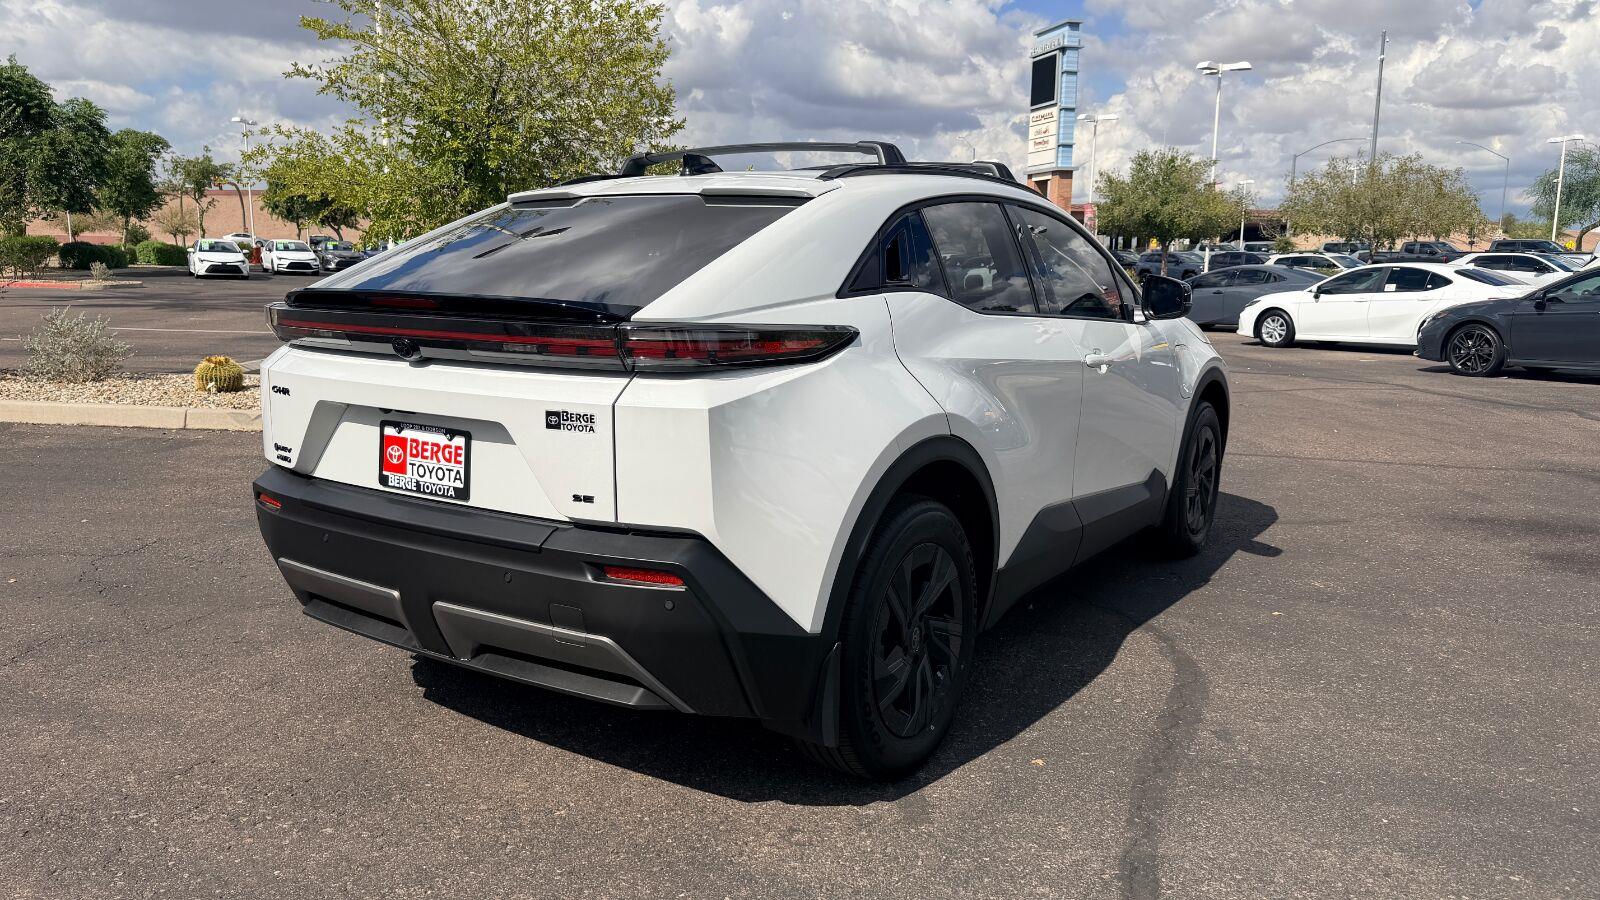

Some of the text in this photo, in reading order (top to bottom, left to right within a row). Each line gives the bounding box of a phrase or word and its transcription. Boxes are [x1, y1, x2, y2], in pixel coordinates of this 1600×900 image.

[561, 411, 595, 423] BERGE
[561, 424, 595, 433] TOYOTA
[409, 438, 463, 465] BERGE
[409, 463, 463, 484] TOYOTA
[388, 475, 417, 490] BERGE
[419, 481, 455, 497] TOYOTA
[572, 494, 594, 503] SE
